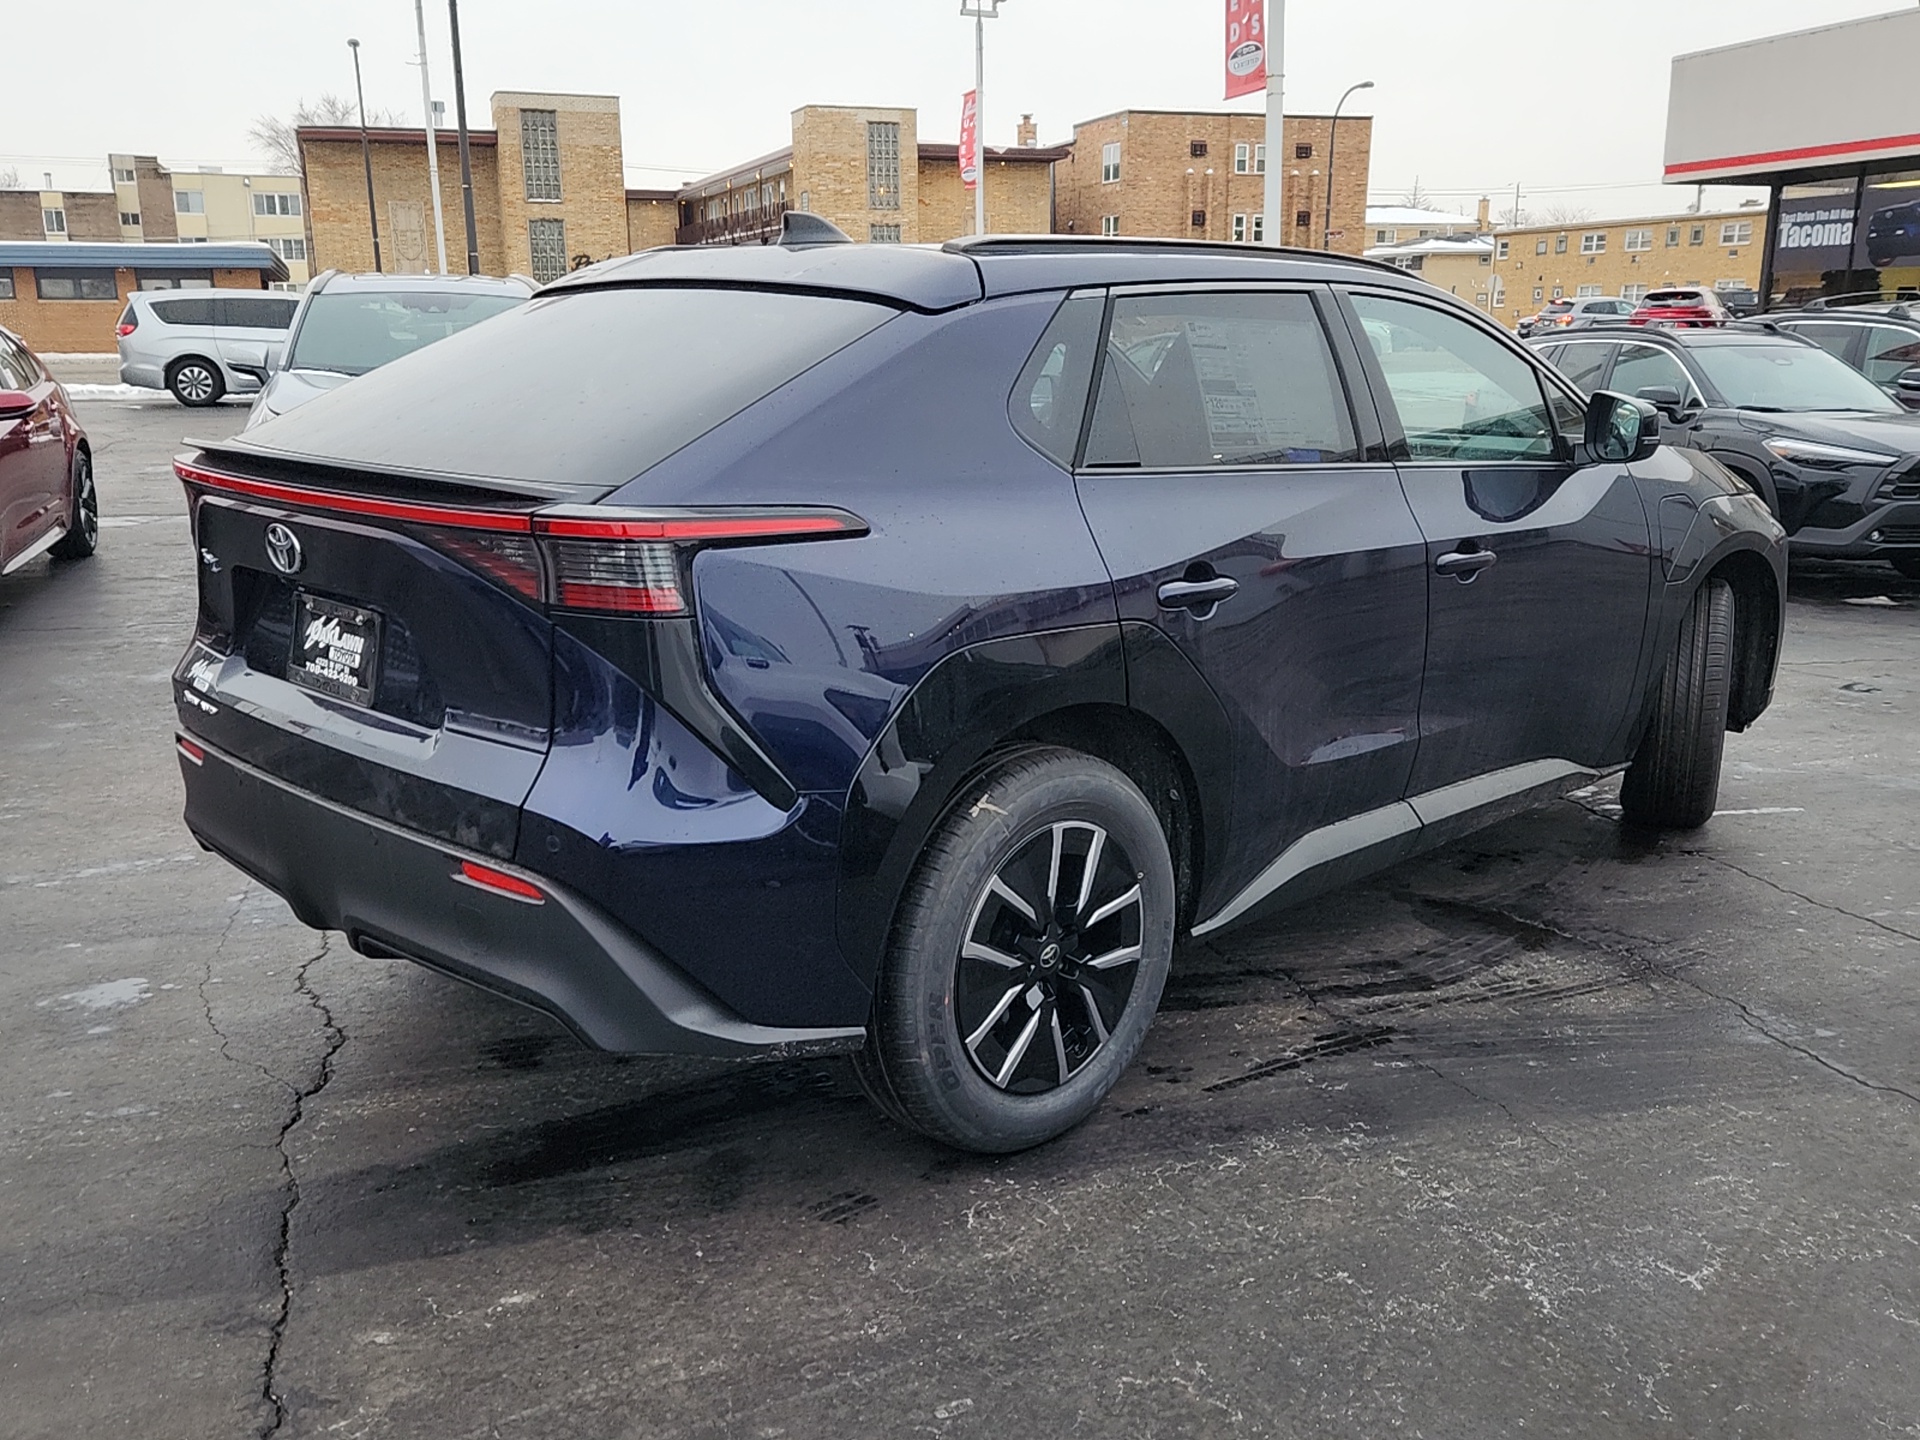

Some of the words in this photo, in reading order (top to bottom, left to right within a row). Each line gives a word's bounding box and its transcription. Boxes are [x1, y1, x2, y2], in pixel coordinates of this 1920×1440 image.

[1782, 213, 1796, 222] Test
[1797, 211, 1815, 222] Drive
[1816, 210, 1829, 220] The
[1779, 222, 1854, 248] Tacoma
[333, 647, 357, 666] TOYOTA
